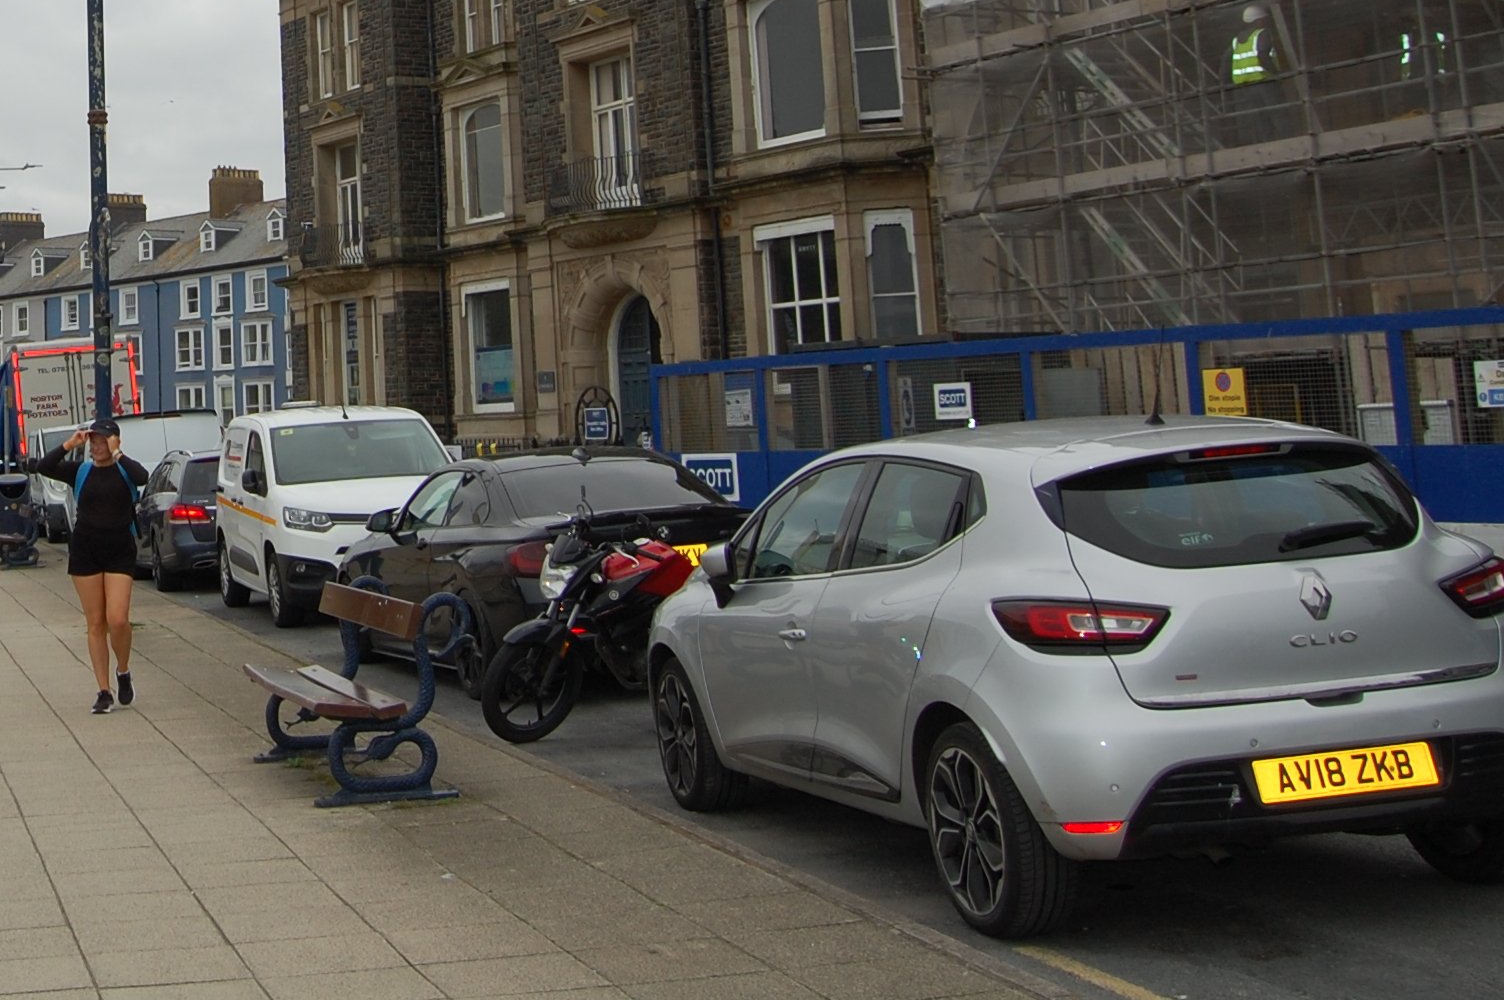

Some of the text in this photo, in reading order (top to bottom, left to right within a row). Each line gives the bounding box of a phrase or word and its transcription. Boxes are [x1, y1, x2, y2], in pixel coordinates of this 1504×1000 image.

[939, 393, 965, 404] SCOTT
[28, 409, 68, 419] POTATOES
[690, 468, 732, 488] COTT
[1289, 629, 1358, 648] CLIO
[1278, 749, 1414, 793] AV18 ZKB
